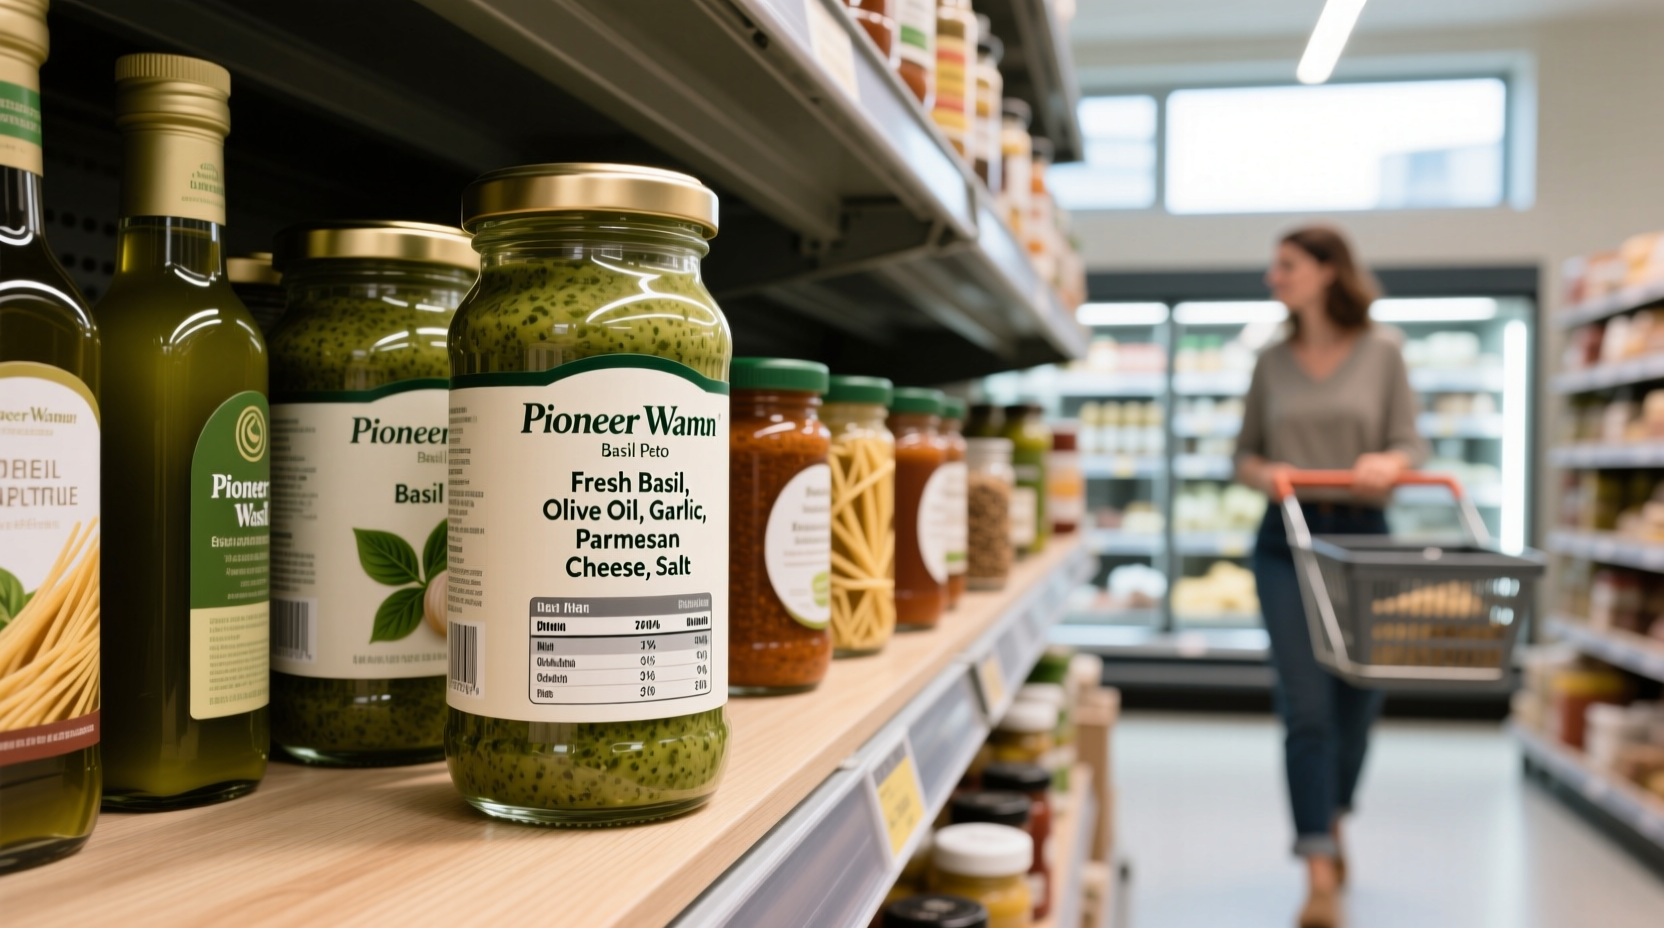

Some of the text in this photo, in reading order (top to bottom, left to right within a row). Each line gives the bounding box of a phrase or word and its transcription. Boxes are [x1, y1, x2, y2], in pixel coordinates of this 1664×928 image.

[521, 403, 641, 435] Pioneer
[601, 442, 636, 458] Basil
[210, 473, 269, 499] Pioneer
[395, 482, 444, 504] Basil
[571, 470, 690, 498] Fresh Basil,
[542, 498, 707, 525] Olive Oil, Garlic,
[576, 528, 680, 550] Parmesan
[565, 554, 692, 582] Cheese, Salt
